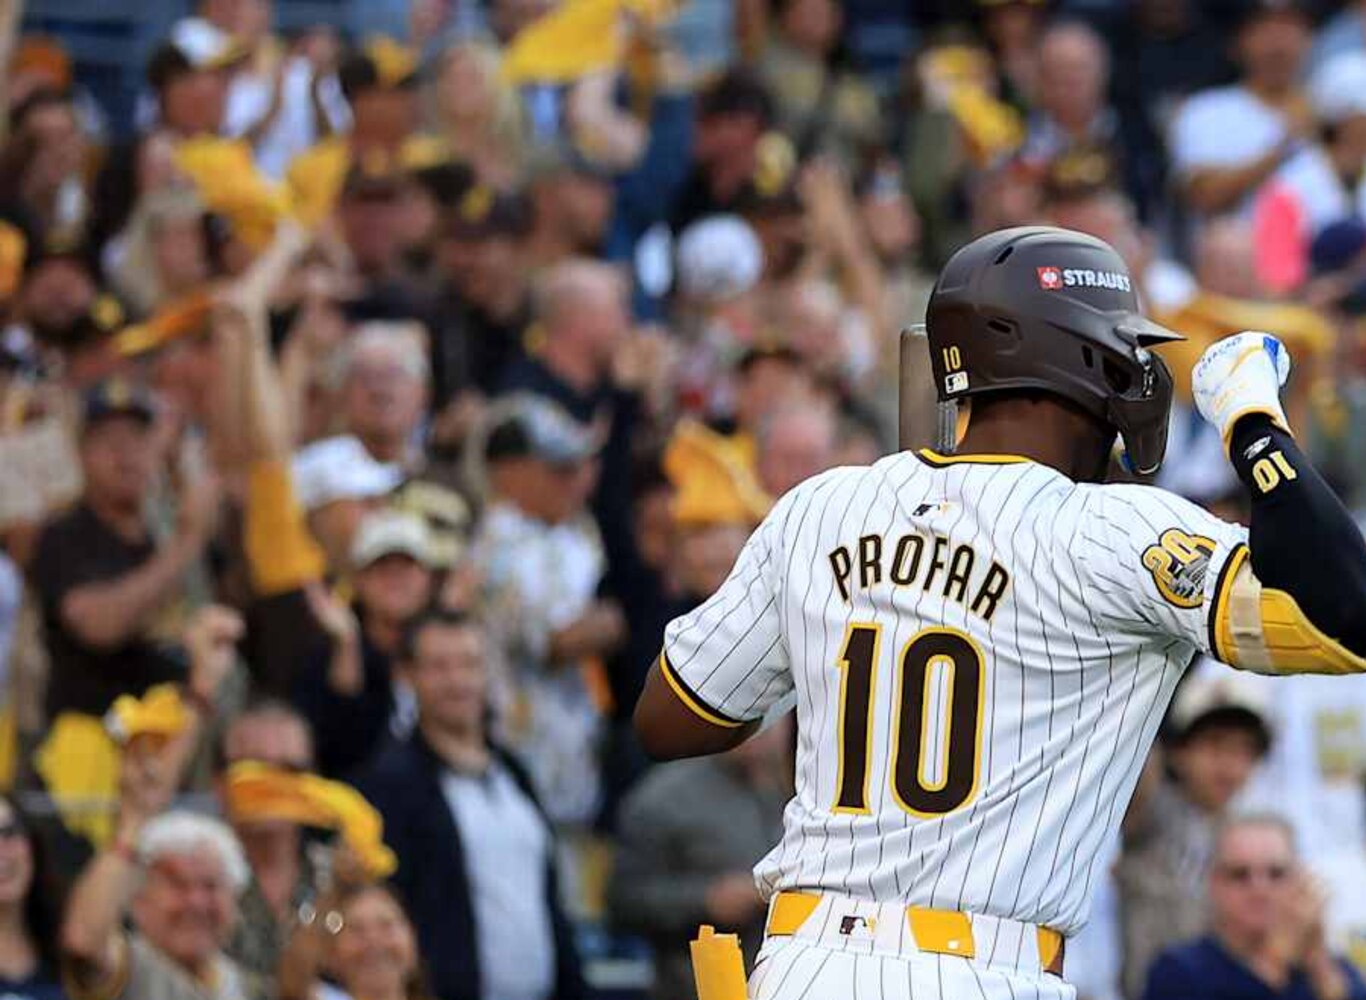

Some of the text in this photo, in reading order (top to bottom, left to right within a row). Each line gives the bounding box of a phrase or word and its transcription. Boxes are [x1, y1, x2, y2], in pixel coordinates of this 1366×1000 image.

[1062, 268, 1130, 292] STRAUSS
[942, 345, 961, 372] 10
[1252, 450, 1297, 493] 10
[829, 533, 1009, 621] PROFAR
[830, 622, 986, 820] 10
